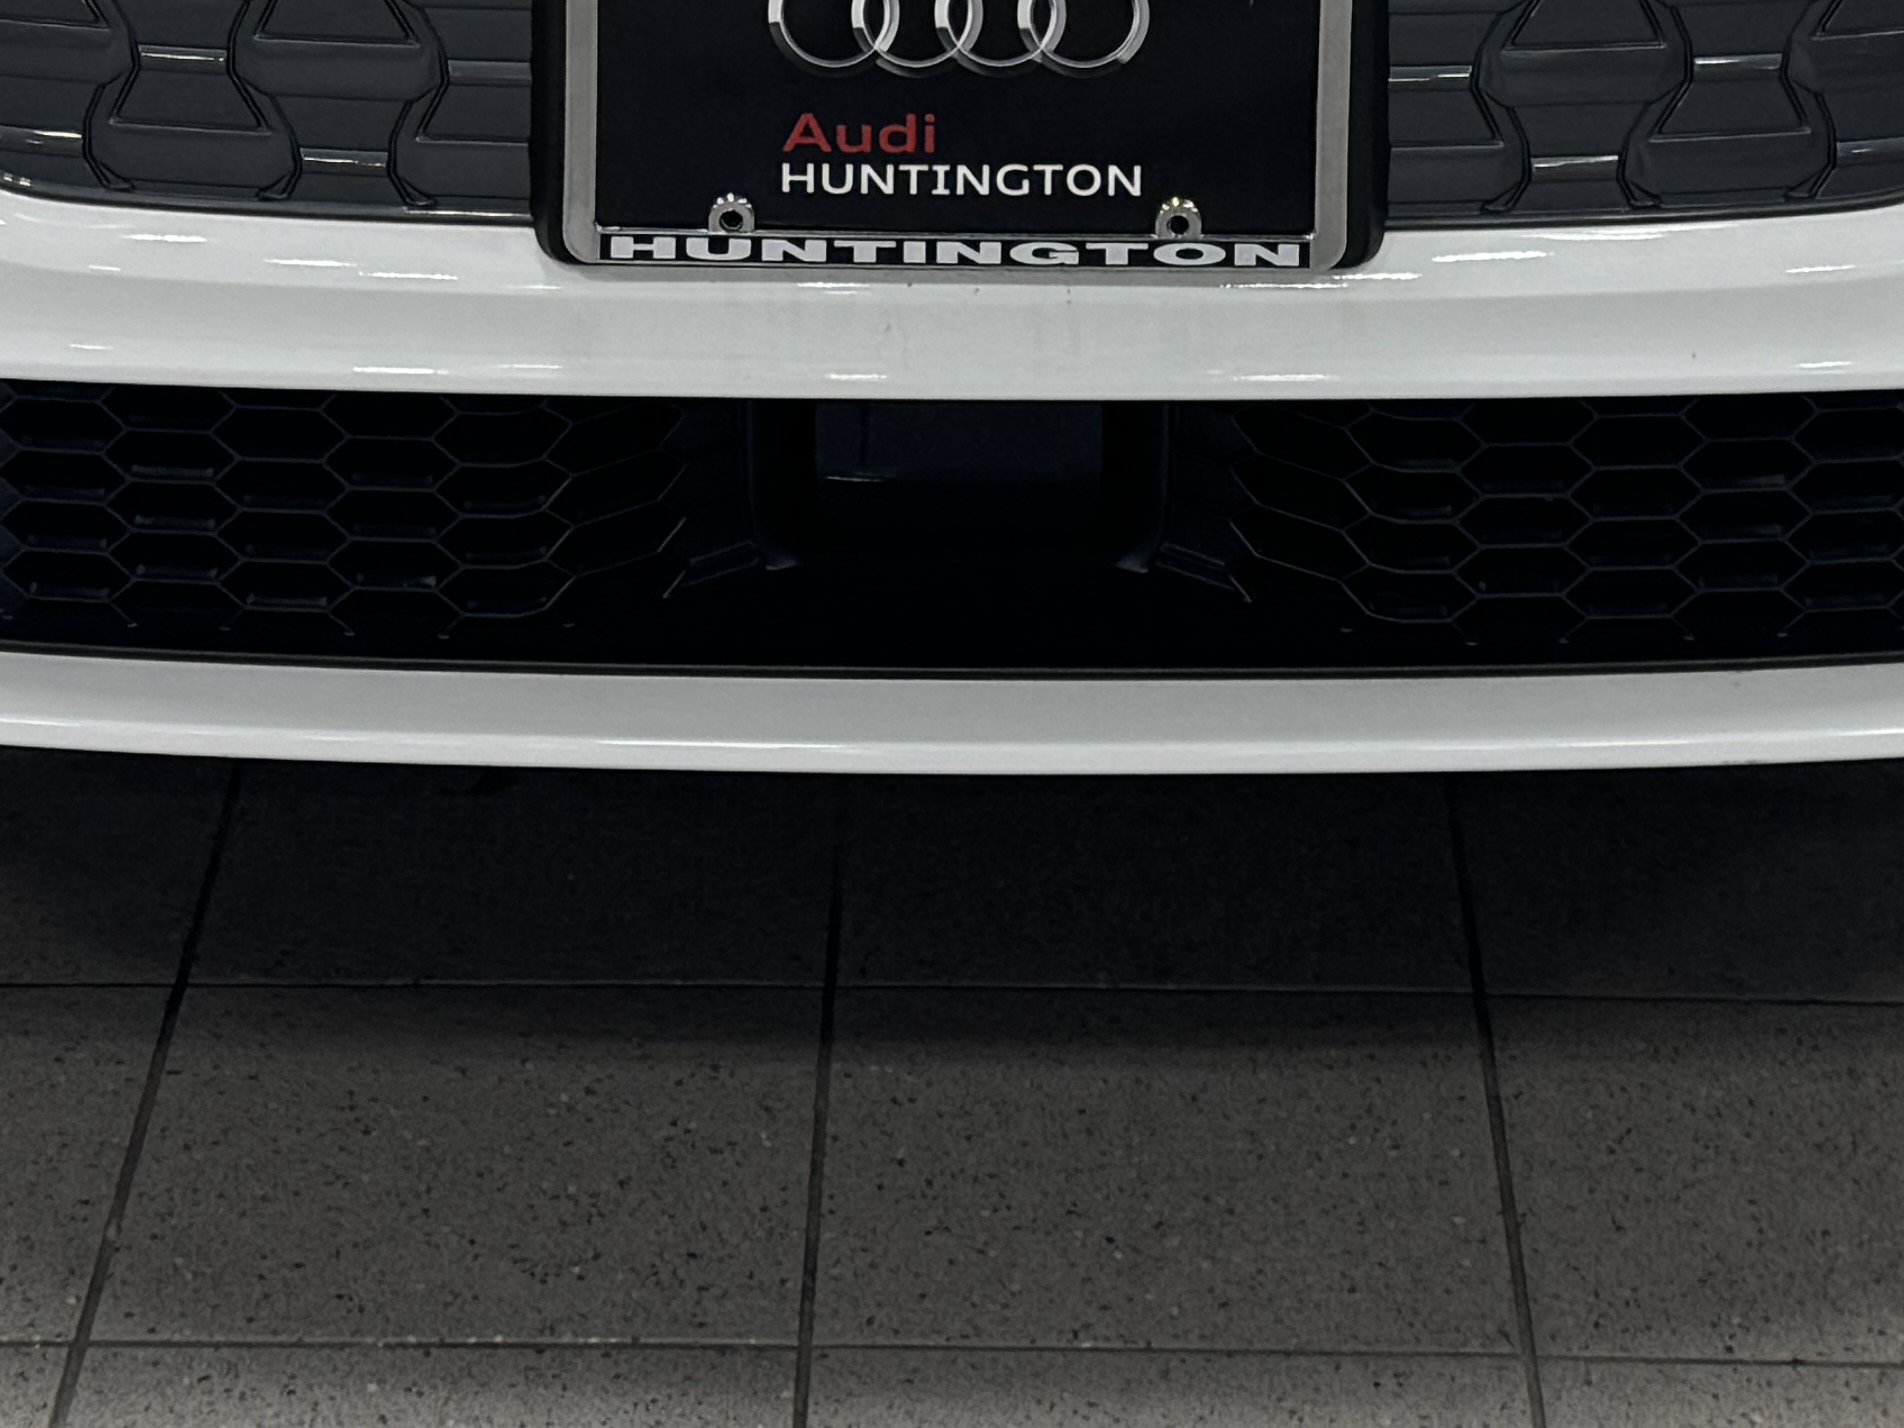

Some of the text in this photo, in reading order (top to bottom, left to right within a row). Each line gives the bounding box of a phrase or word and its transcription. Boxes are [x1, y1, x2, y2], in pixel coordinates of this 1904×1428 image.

[782, 112, 937, 156] Audi
[781, 163, 1143, 198] HUNTINGTON
[609, 235, 1302, 268] HUNTINGTON
